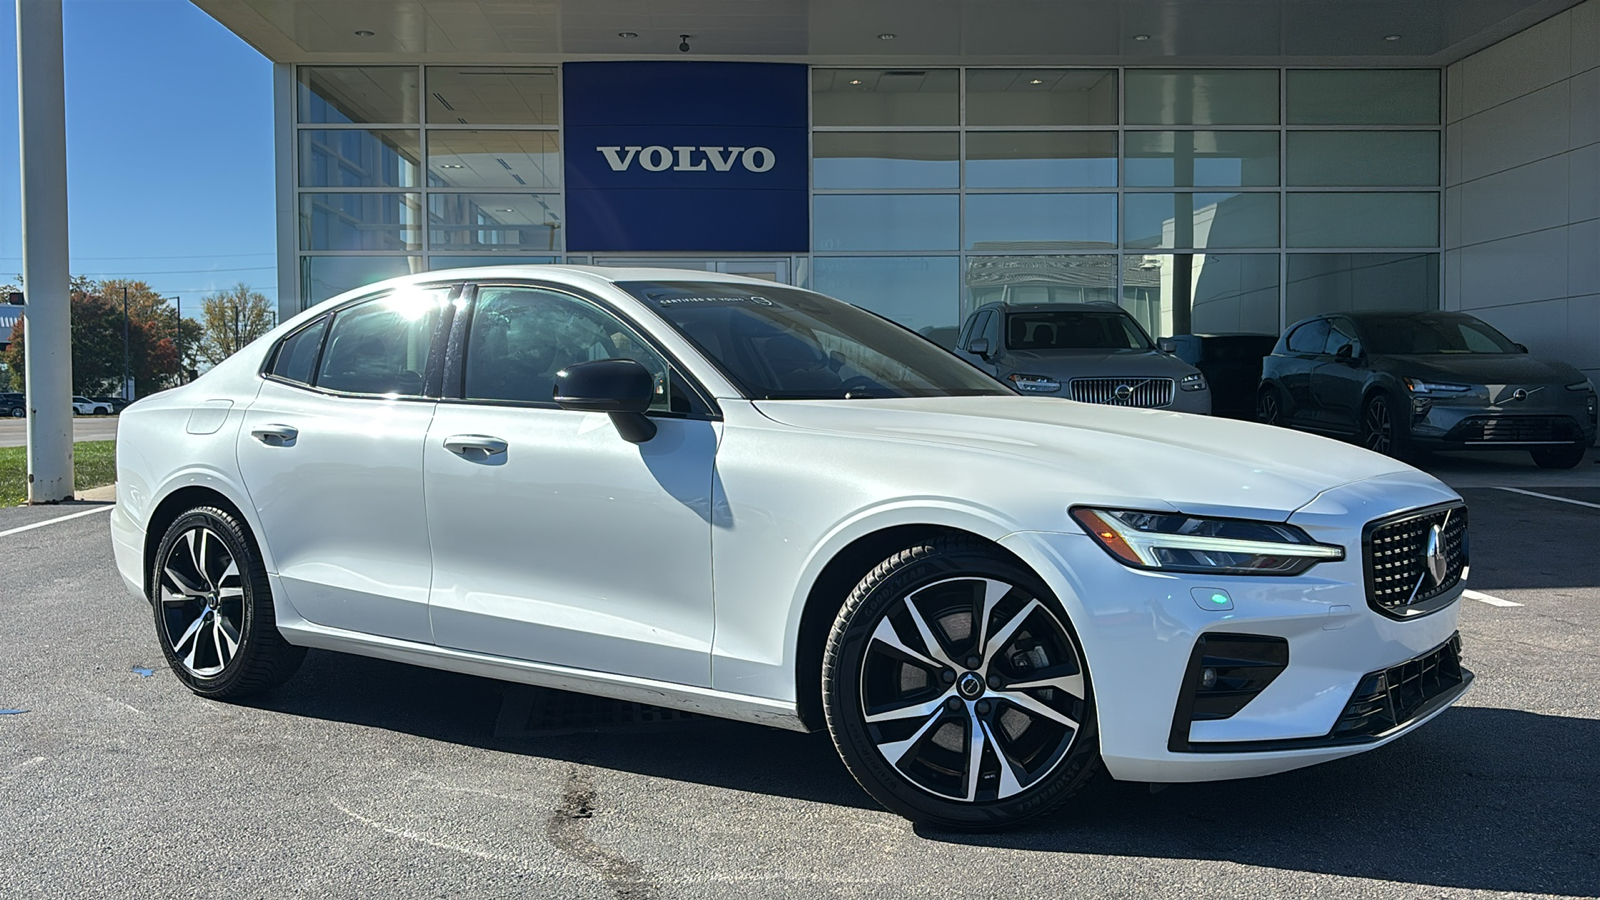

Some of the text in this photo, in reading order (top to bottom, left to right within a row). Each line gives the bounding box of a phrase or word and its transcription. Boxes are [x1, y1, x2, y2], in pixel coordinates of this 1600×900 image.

[596, 145, 776, 173] VOLVO
[660, 297, 705, 305] CERTIFIED
[865, 566, 926, 618] GOODYEAR
